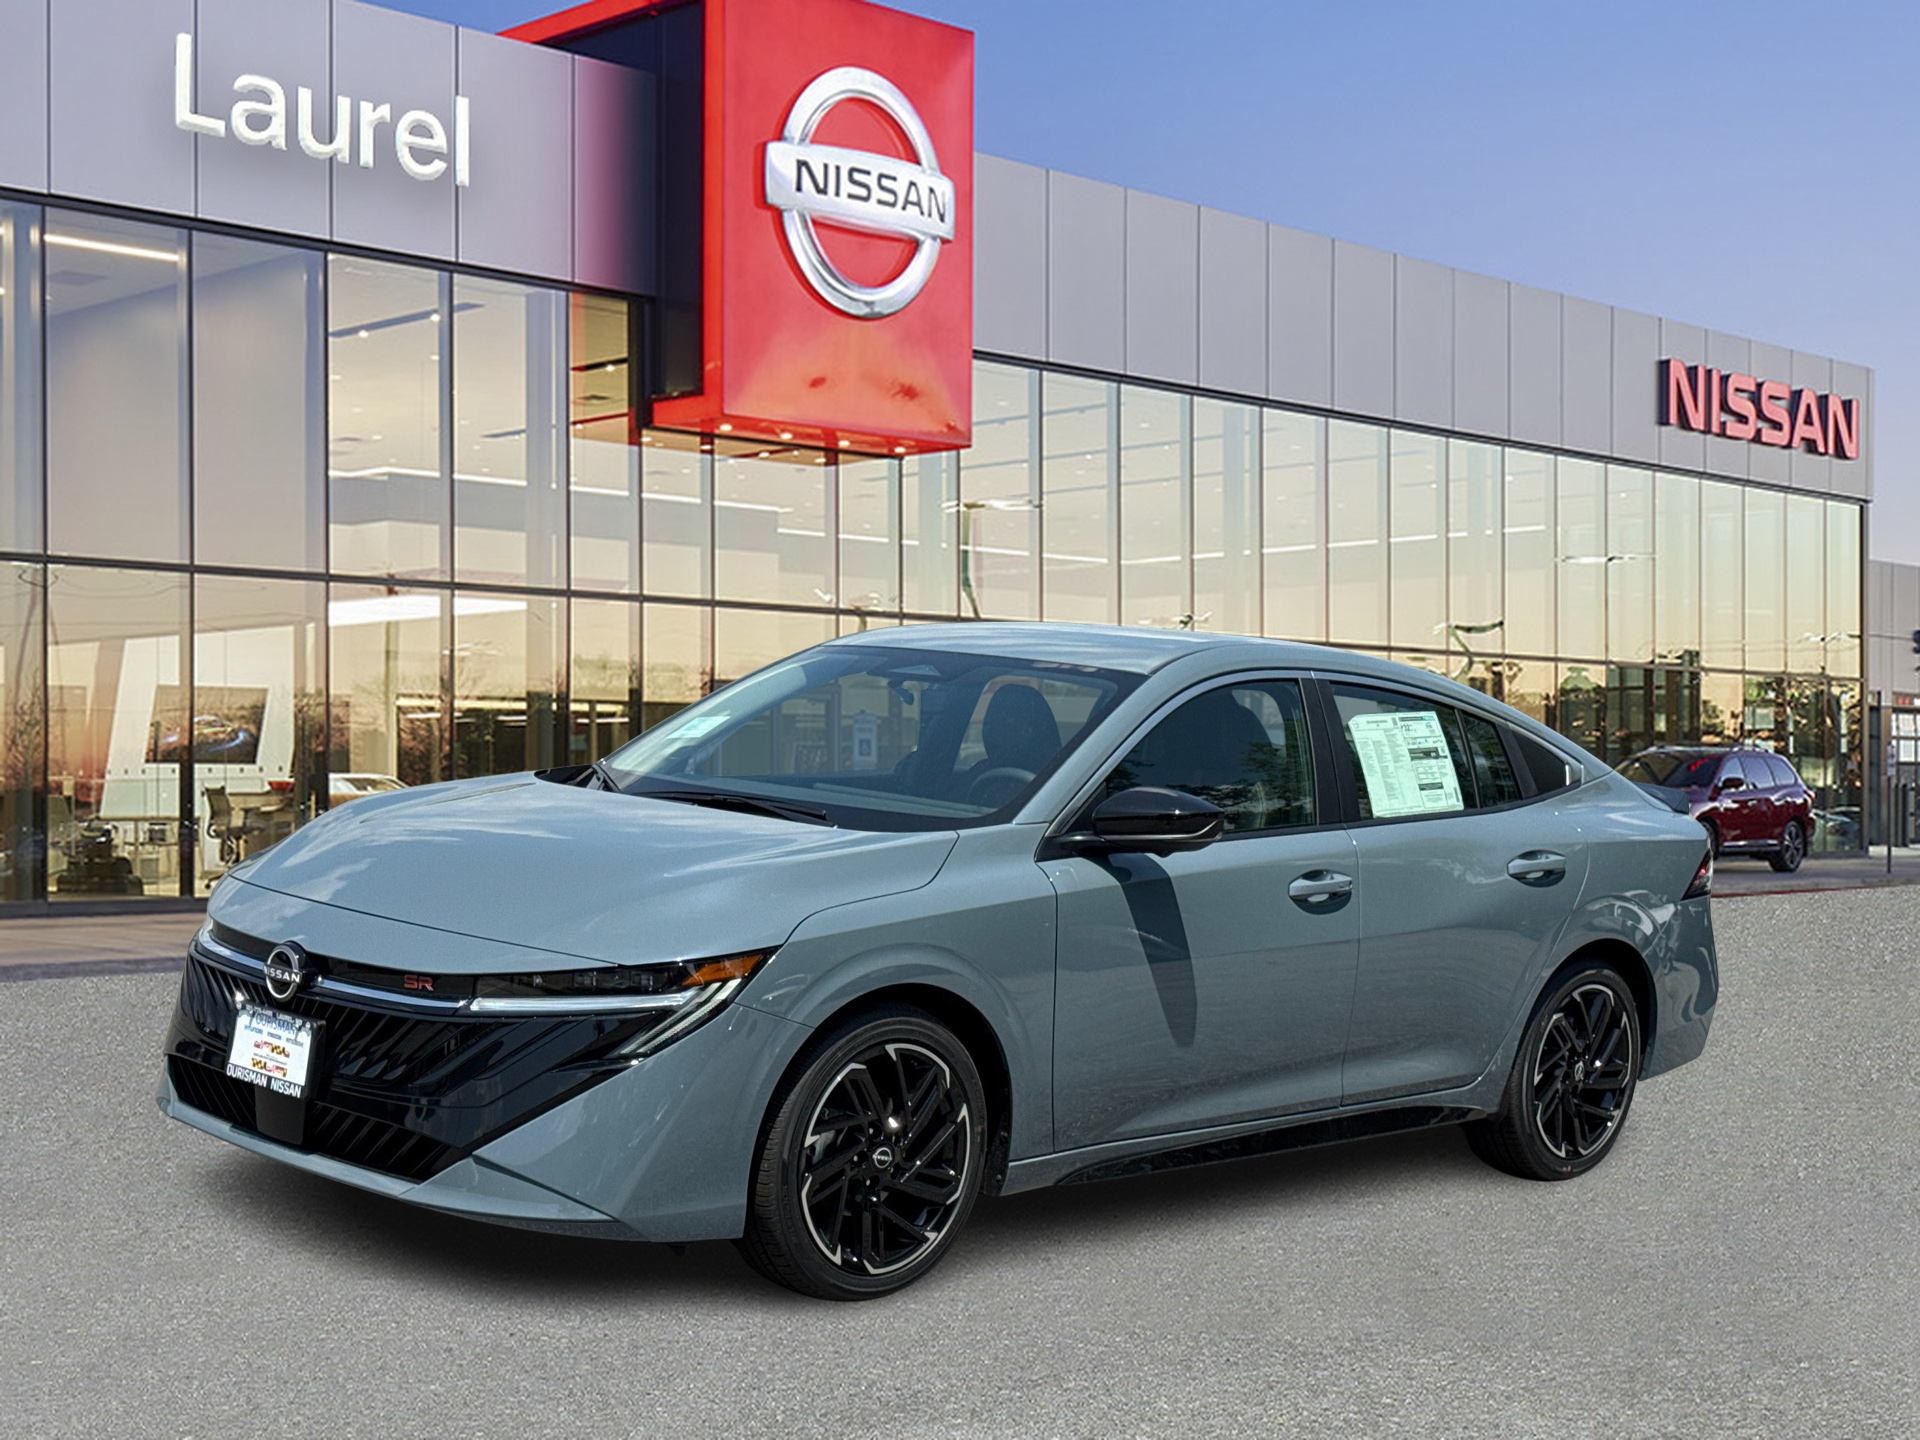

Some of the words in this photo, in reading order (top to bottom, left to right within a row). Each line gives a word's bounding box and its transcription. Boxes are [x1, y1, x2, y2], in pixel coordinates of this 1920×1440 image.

[175, 32, 470, 188] Laurel
[795, 158, 947, 223] NISSAN
[1660, 357, 1860, 460] NISSAN
[403, 974, 434, 991] SR
[226, 1063, 268, 1088] OURISMAN
[270, 1078, 302, 1099] NISSAN
